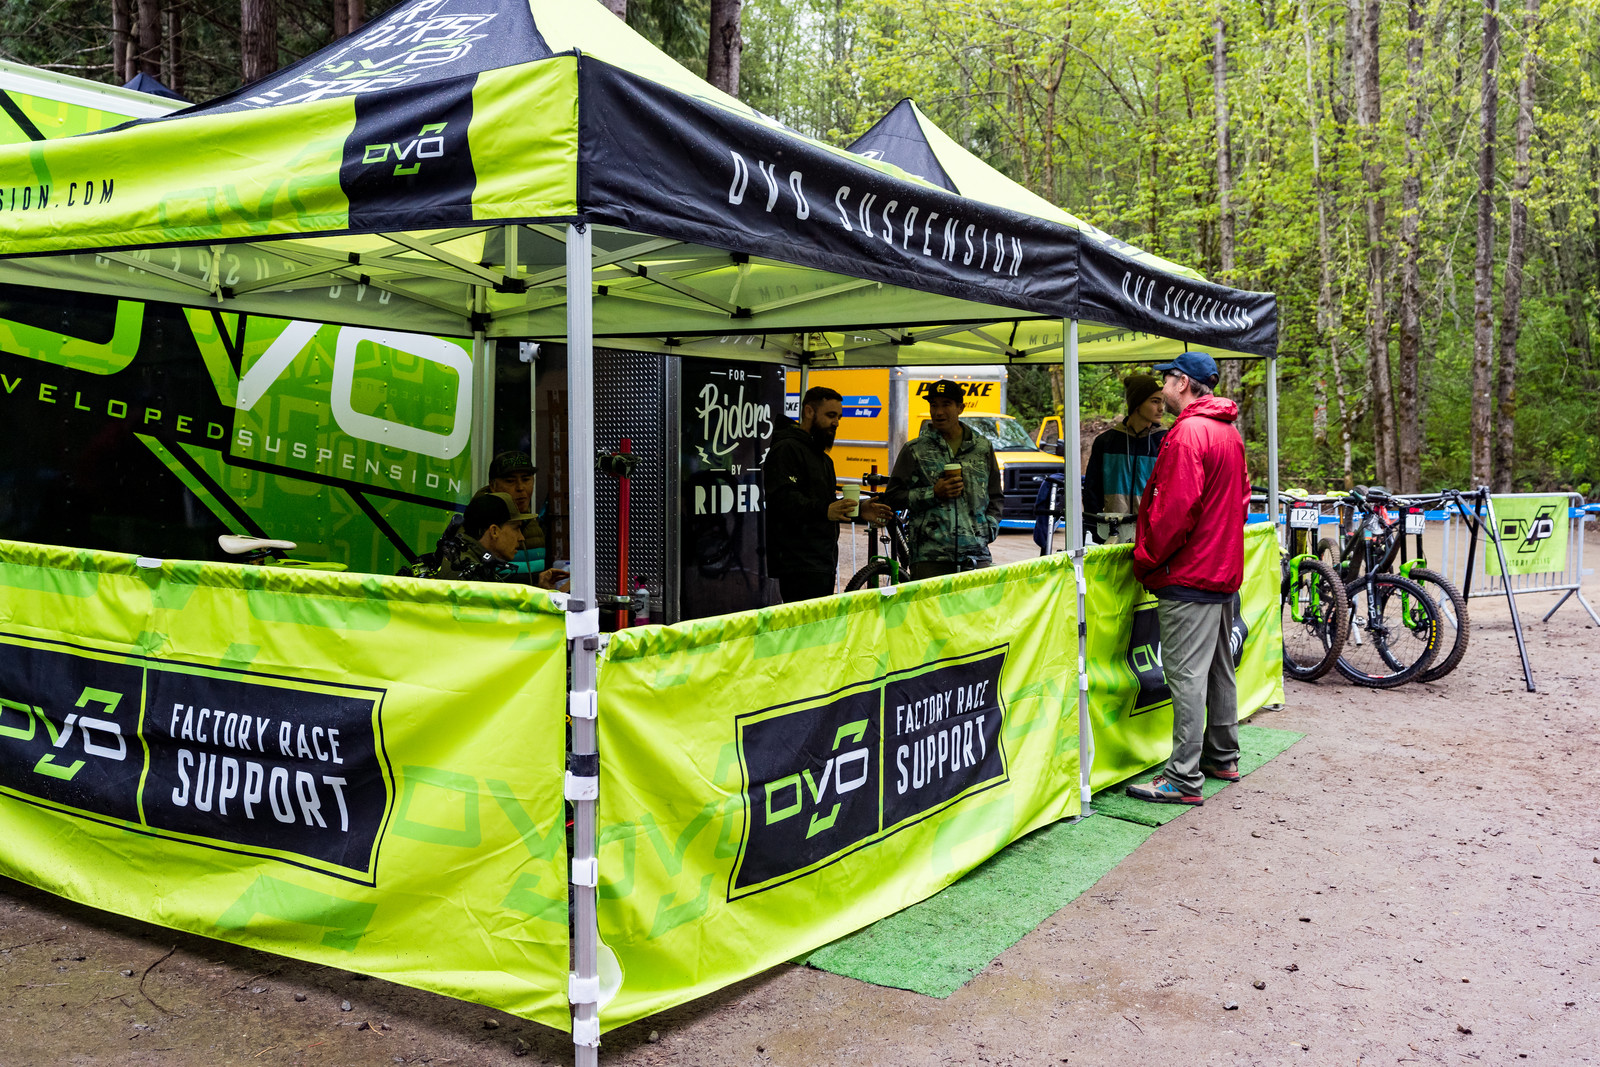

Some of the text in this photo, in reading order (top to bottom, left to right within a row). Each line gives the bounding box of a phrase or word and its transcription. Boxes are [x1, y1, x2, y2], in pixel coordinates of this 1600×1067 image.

[360, 134, 446, 166] DVO
[728, 150, 1023, 276] DVO SUSPENSION
[1122, 271, 1253, 329] DVO SUSPENSION
[728, 369, 745, 381] FOR
[916, 382, 994, 396] PSKE
[695, 383, 773, 456] Riders
[237, 429, 462, 493] SUSPENSION
[731, 464, 742, 475] BY
[694, 484, 767, 515] RIDER
[1296, 510, 1315, 521] 128
[1367, 596, 1377, 619] DVO
[170, 703, 343, 764] FACTORY RACE
[896, 679, 989, 736] FACTORY RACE
[896, 714, 986, 795] SUPPORT
[171, 748, 349, 832] SUPPORT
[764, 747, 869, 826] DVO
